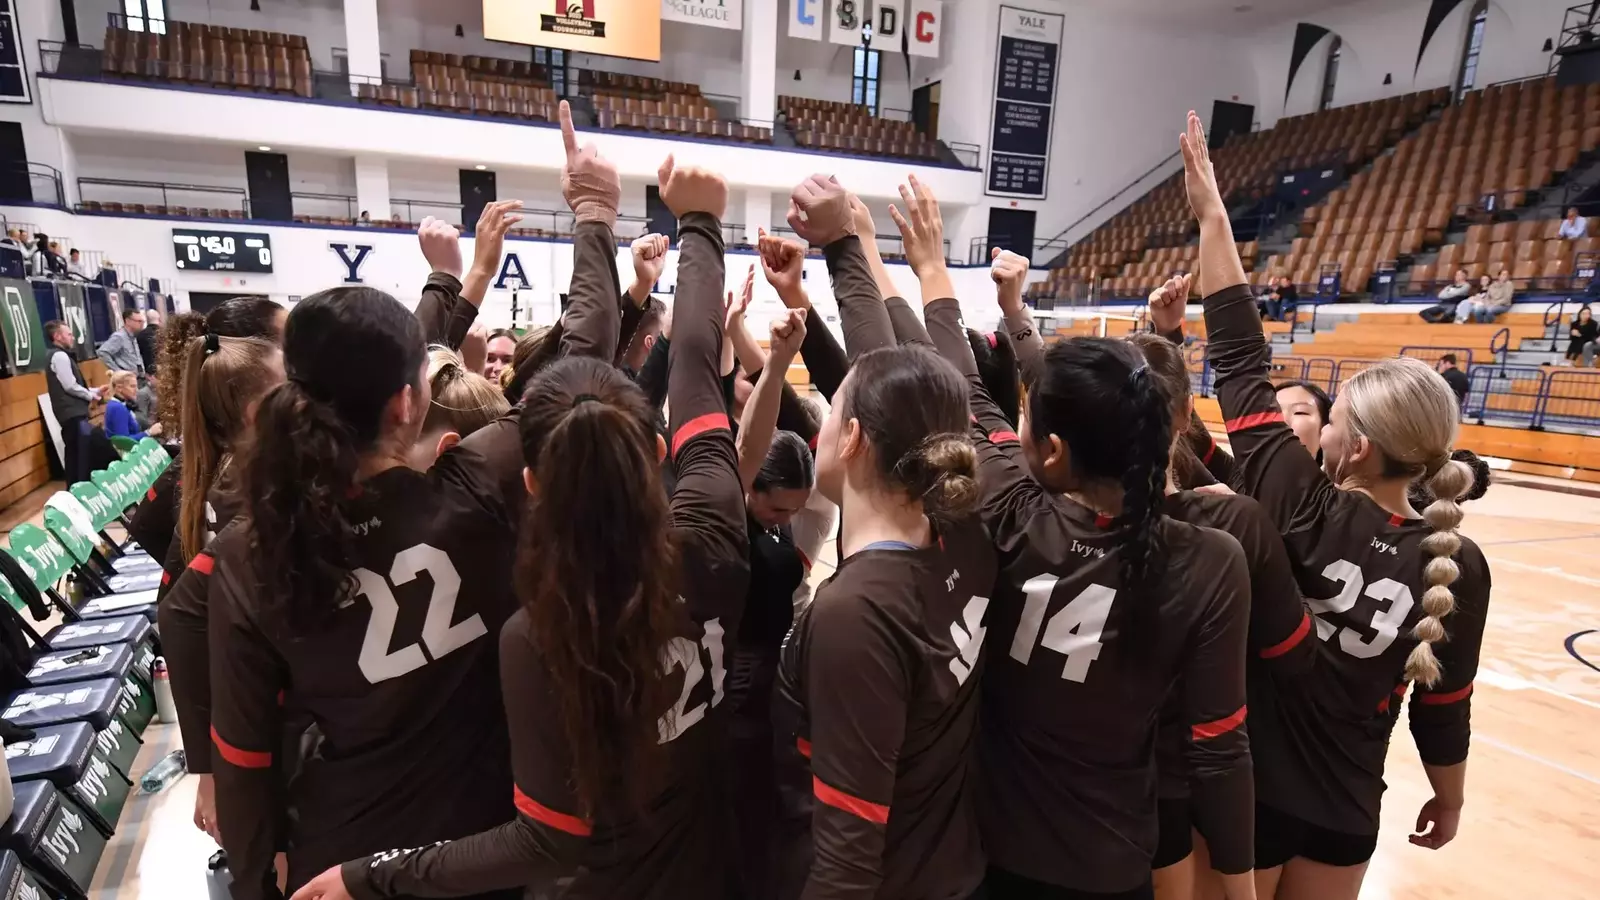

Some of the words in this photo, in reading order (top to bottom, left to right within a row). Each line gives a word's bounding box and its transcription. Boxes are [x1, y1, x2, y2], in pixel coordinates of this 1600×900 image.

[683, 4, 729, 21] LEAGUE
[879, 5, 896, 36] D
[916, 11, 935, 43] C
[1018, 15, 1046, 29] YALE
[552, 25, 595, 36] TOURNAMENT
[187, 244, 200, 262] 0
[258, 247, 271, 265] 0
[24, 543, 58, 570] Ivy
[1071, 540, 1094, 558] Ivy
[1370, 537, 1390, 553] Ivy
[340, 543, 488, 684] 22
[1303, 558, 1414, 659] 23
[1009, 572, 1117, 683] 14
[656, 617, 727, 745] 21
[75, 766, 107, 805] Ivy
[42, 820, 80, 865] Ivy
